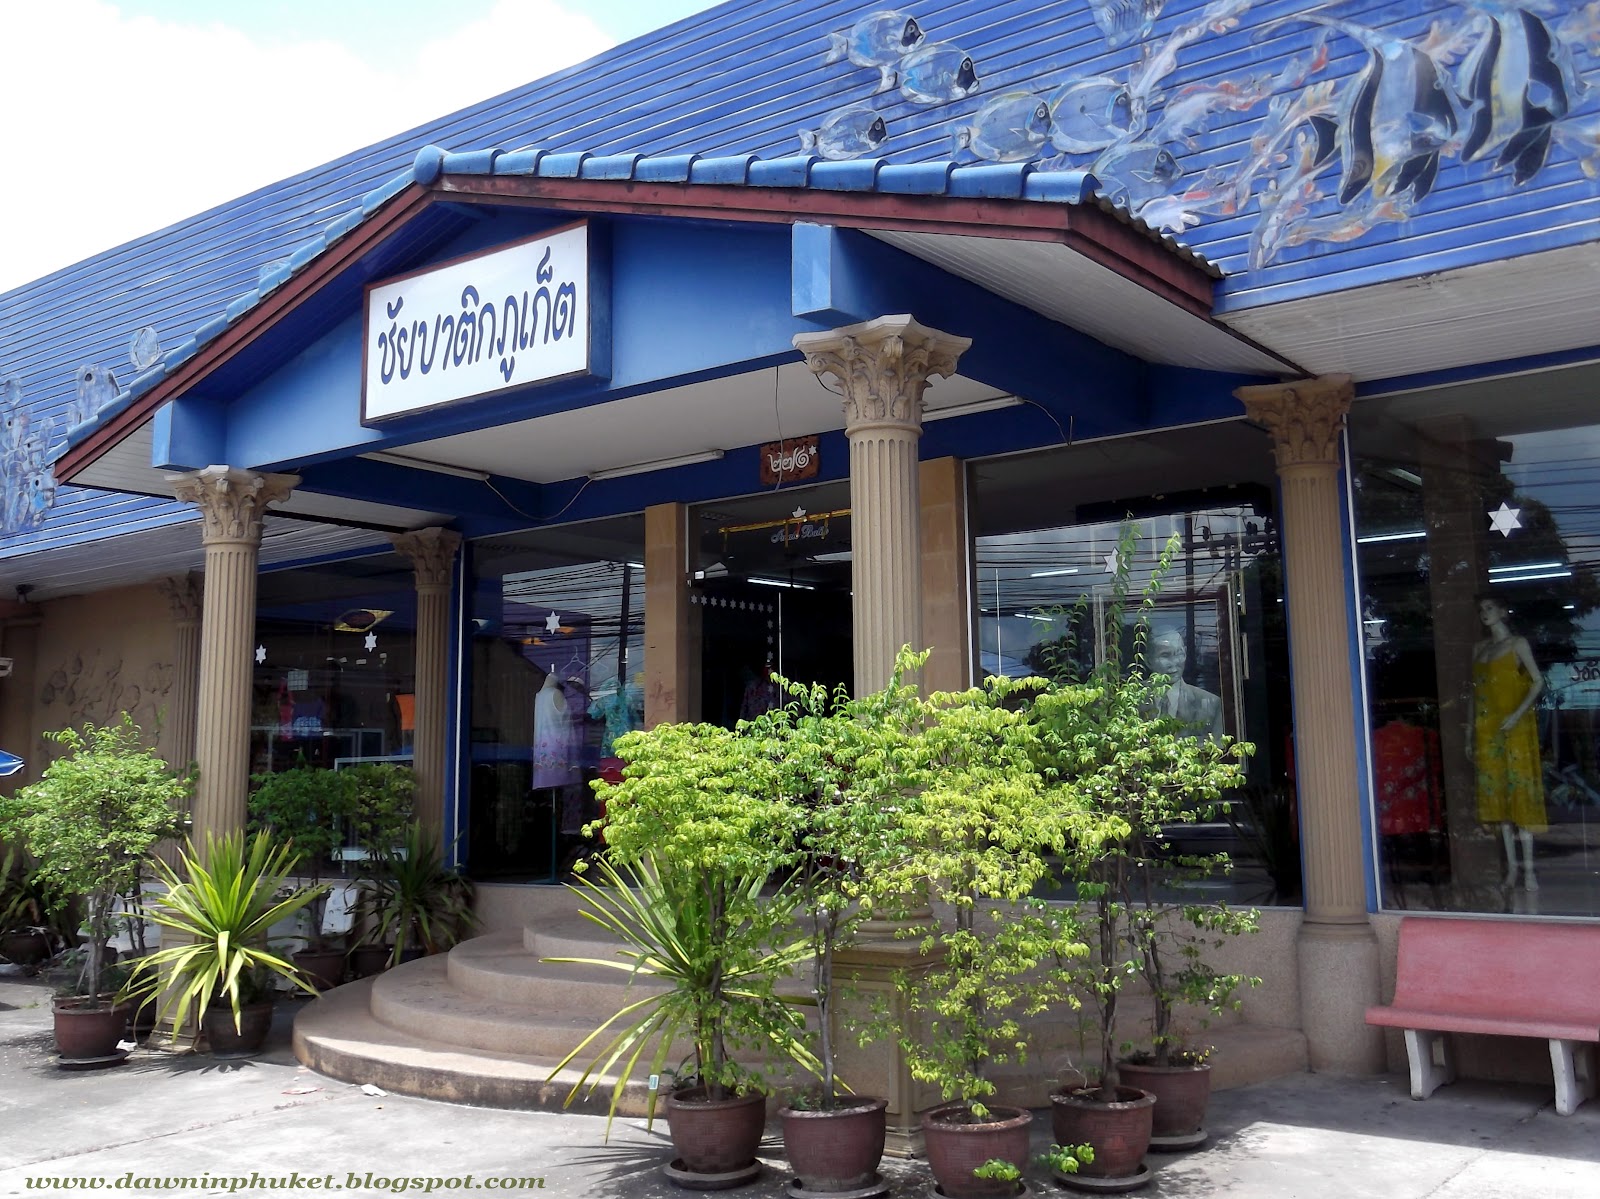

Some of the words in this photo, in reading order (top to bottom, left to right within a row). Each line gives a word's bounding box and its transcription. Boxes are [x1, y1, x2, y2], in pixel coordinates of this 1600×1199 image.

[378, 246, 576, 385] ชัยบาติกภูเก็ต
